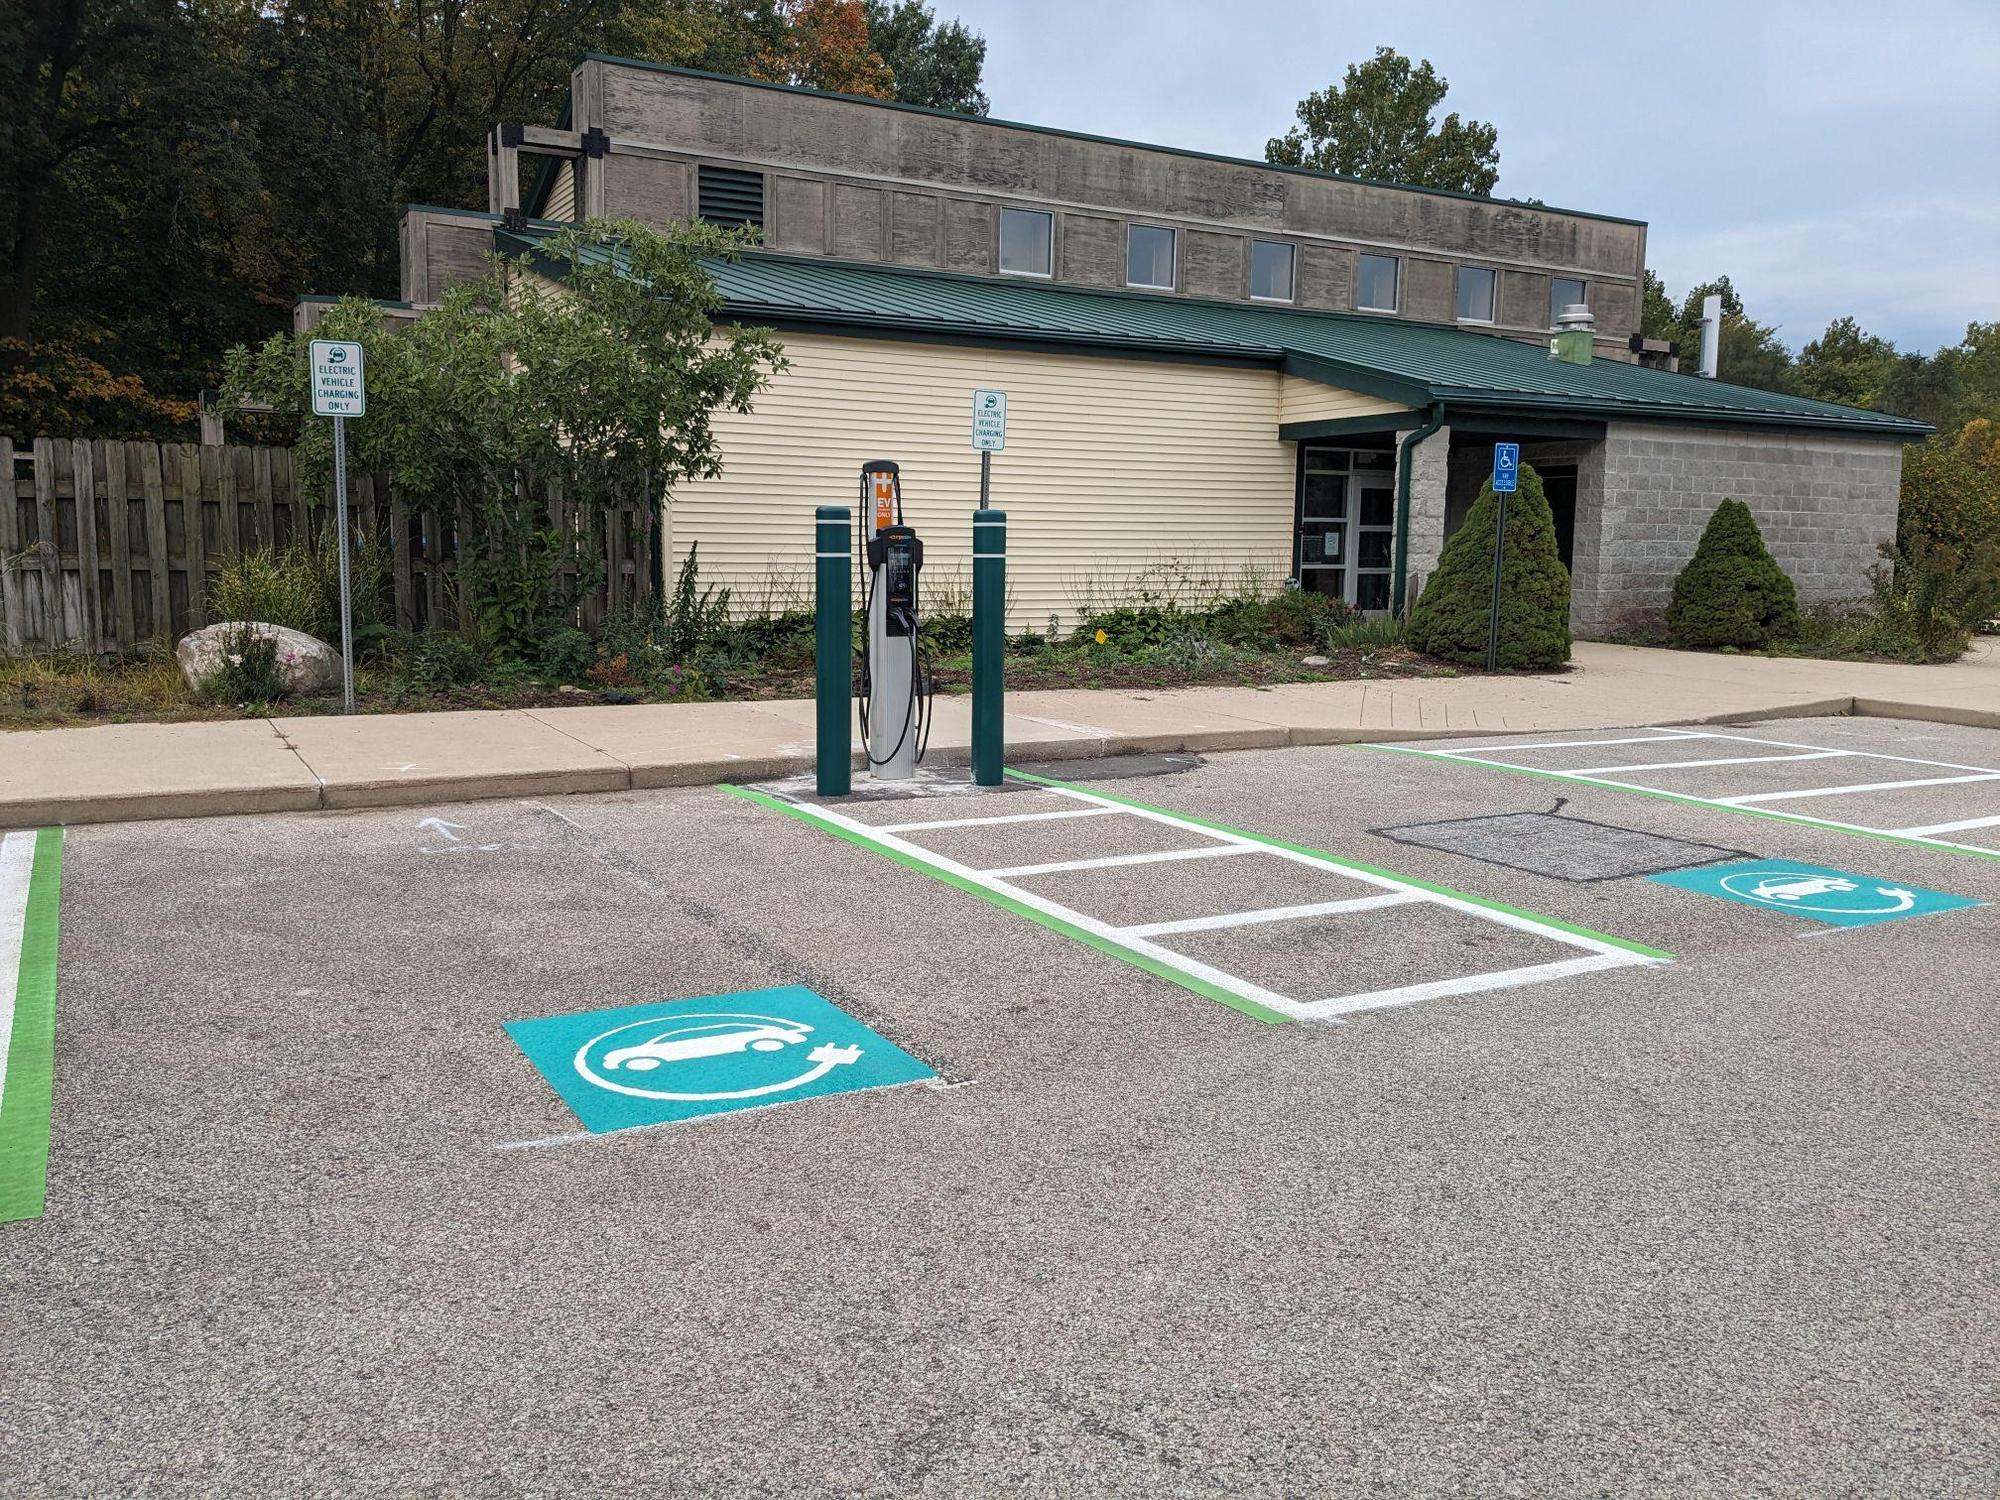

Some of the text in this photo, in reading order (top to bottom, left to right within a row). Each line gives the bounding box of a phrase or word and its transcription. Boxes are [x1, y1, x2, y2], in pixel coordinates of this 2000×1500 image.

[319, 365, 356, 375] ELECTRIC
[321, 377, 354, 387] VEHICLE
[317, 389, 359, 399] CHARGING
[328, 401, 350, 411] ONLY
[978, 409, 1001, 418] ELECTRIC
[978, 419, 1000, 428] VEHICLE
[975, 429, 1002, 437] CHARGING
[981, 439, 996, 447] ONLY
[877, 497, 891, 507] EV
